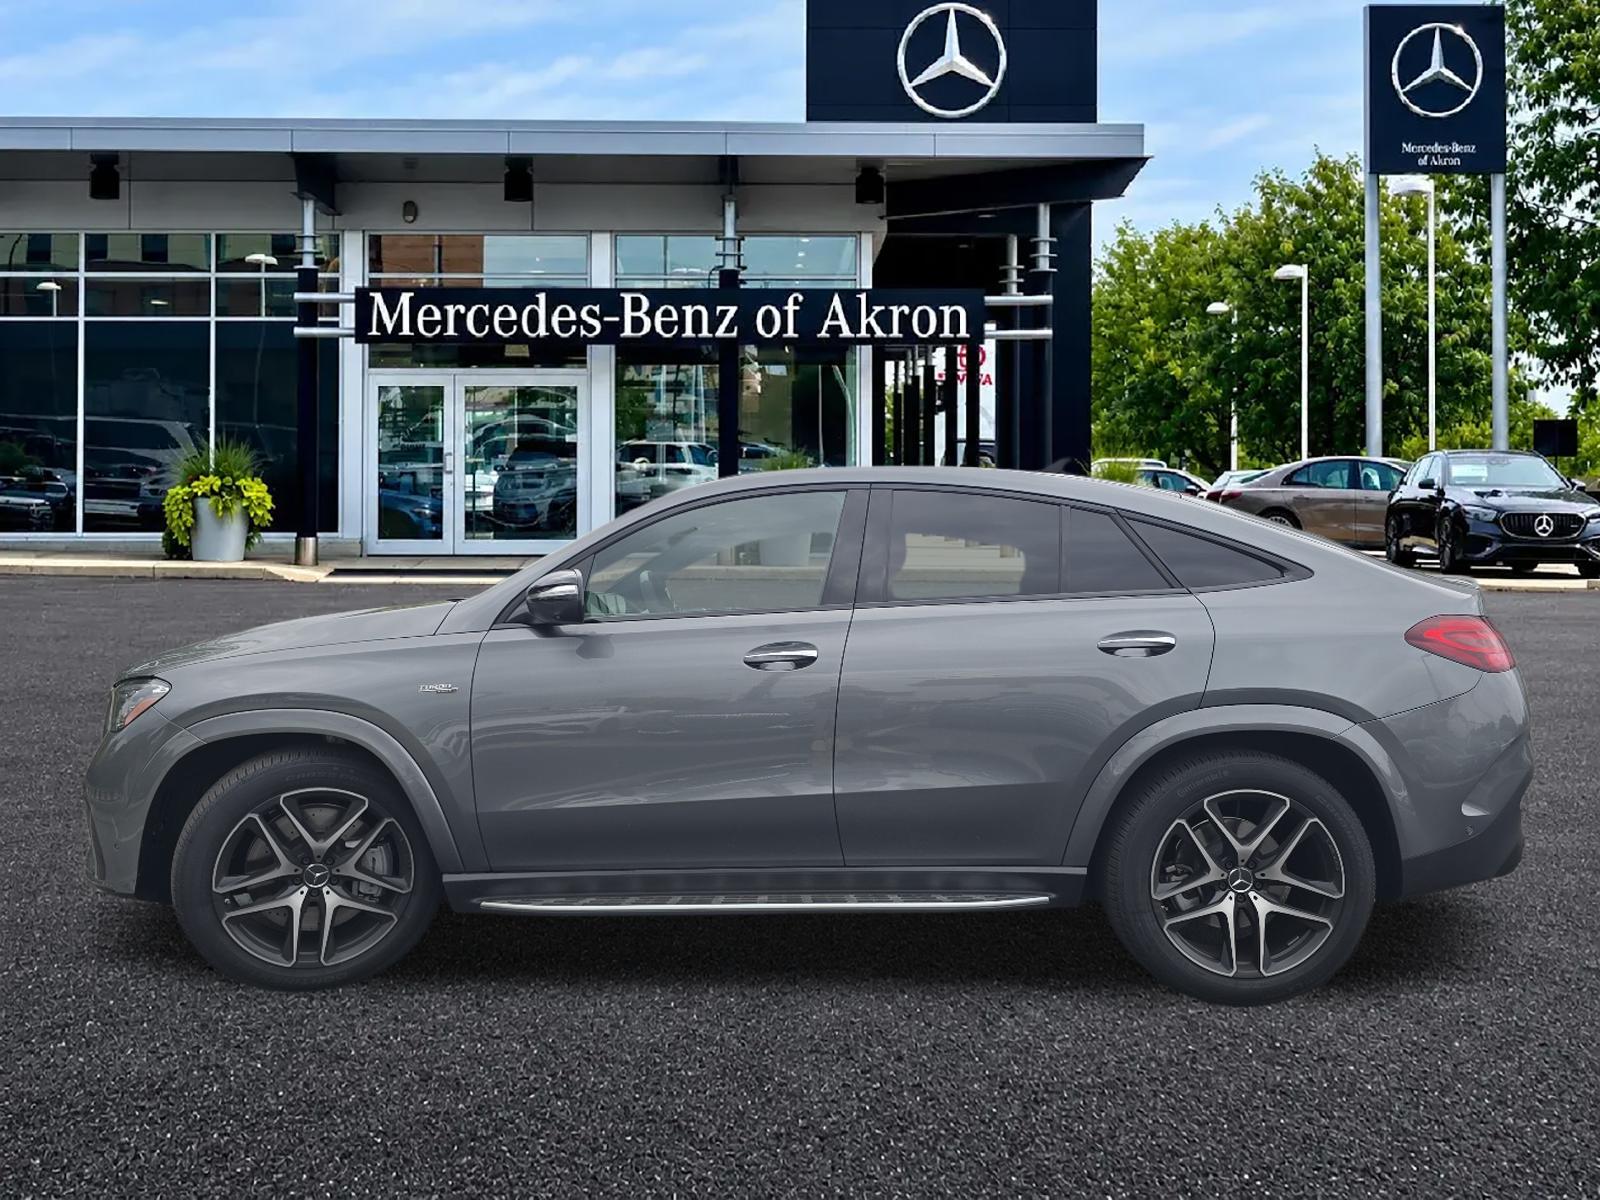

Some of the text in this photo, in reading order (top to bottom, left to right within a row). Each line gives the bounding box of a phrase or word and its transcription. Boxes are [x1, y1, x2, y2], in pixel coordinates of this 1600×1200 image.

[1401, 141, 1476, 153] Mercedes-Benz
[1417, 154, 1460, 166] of Akron
[367, 291, 971, 338] Mercedes-Benz of Akron
